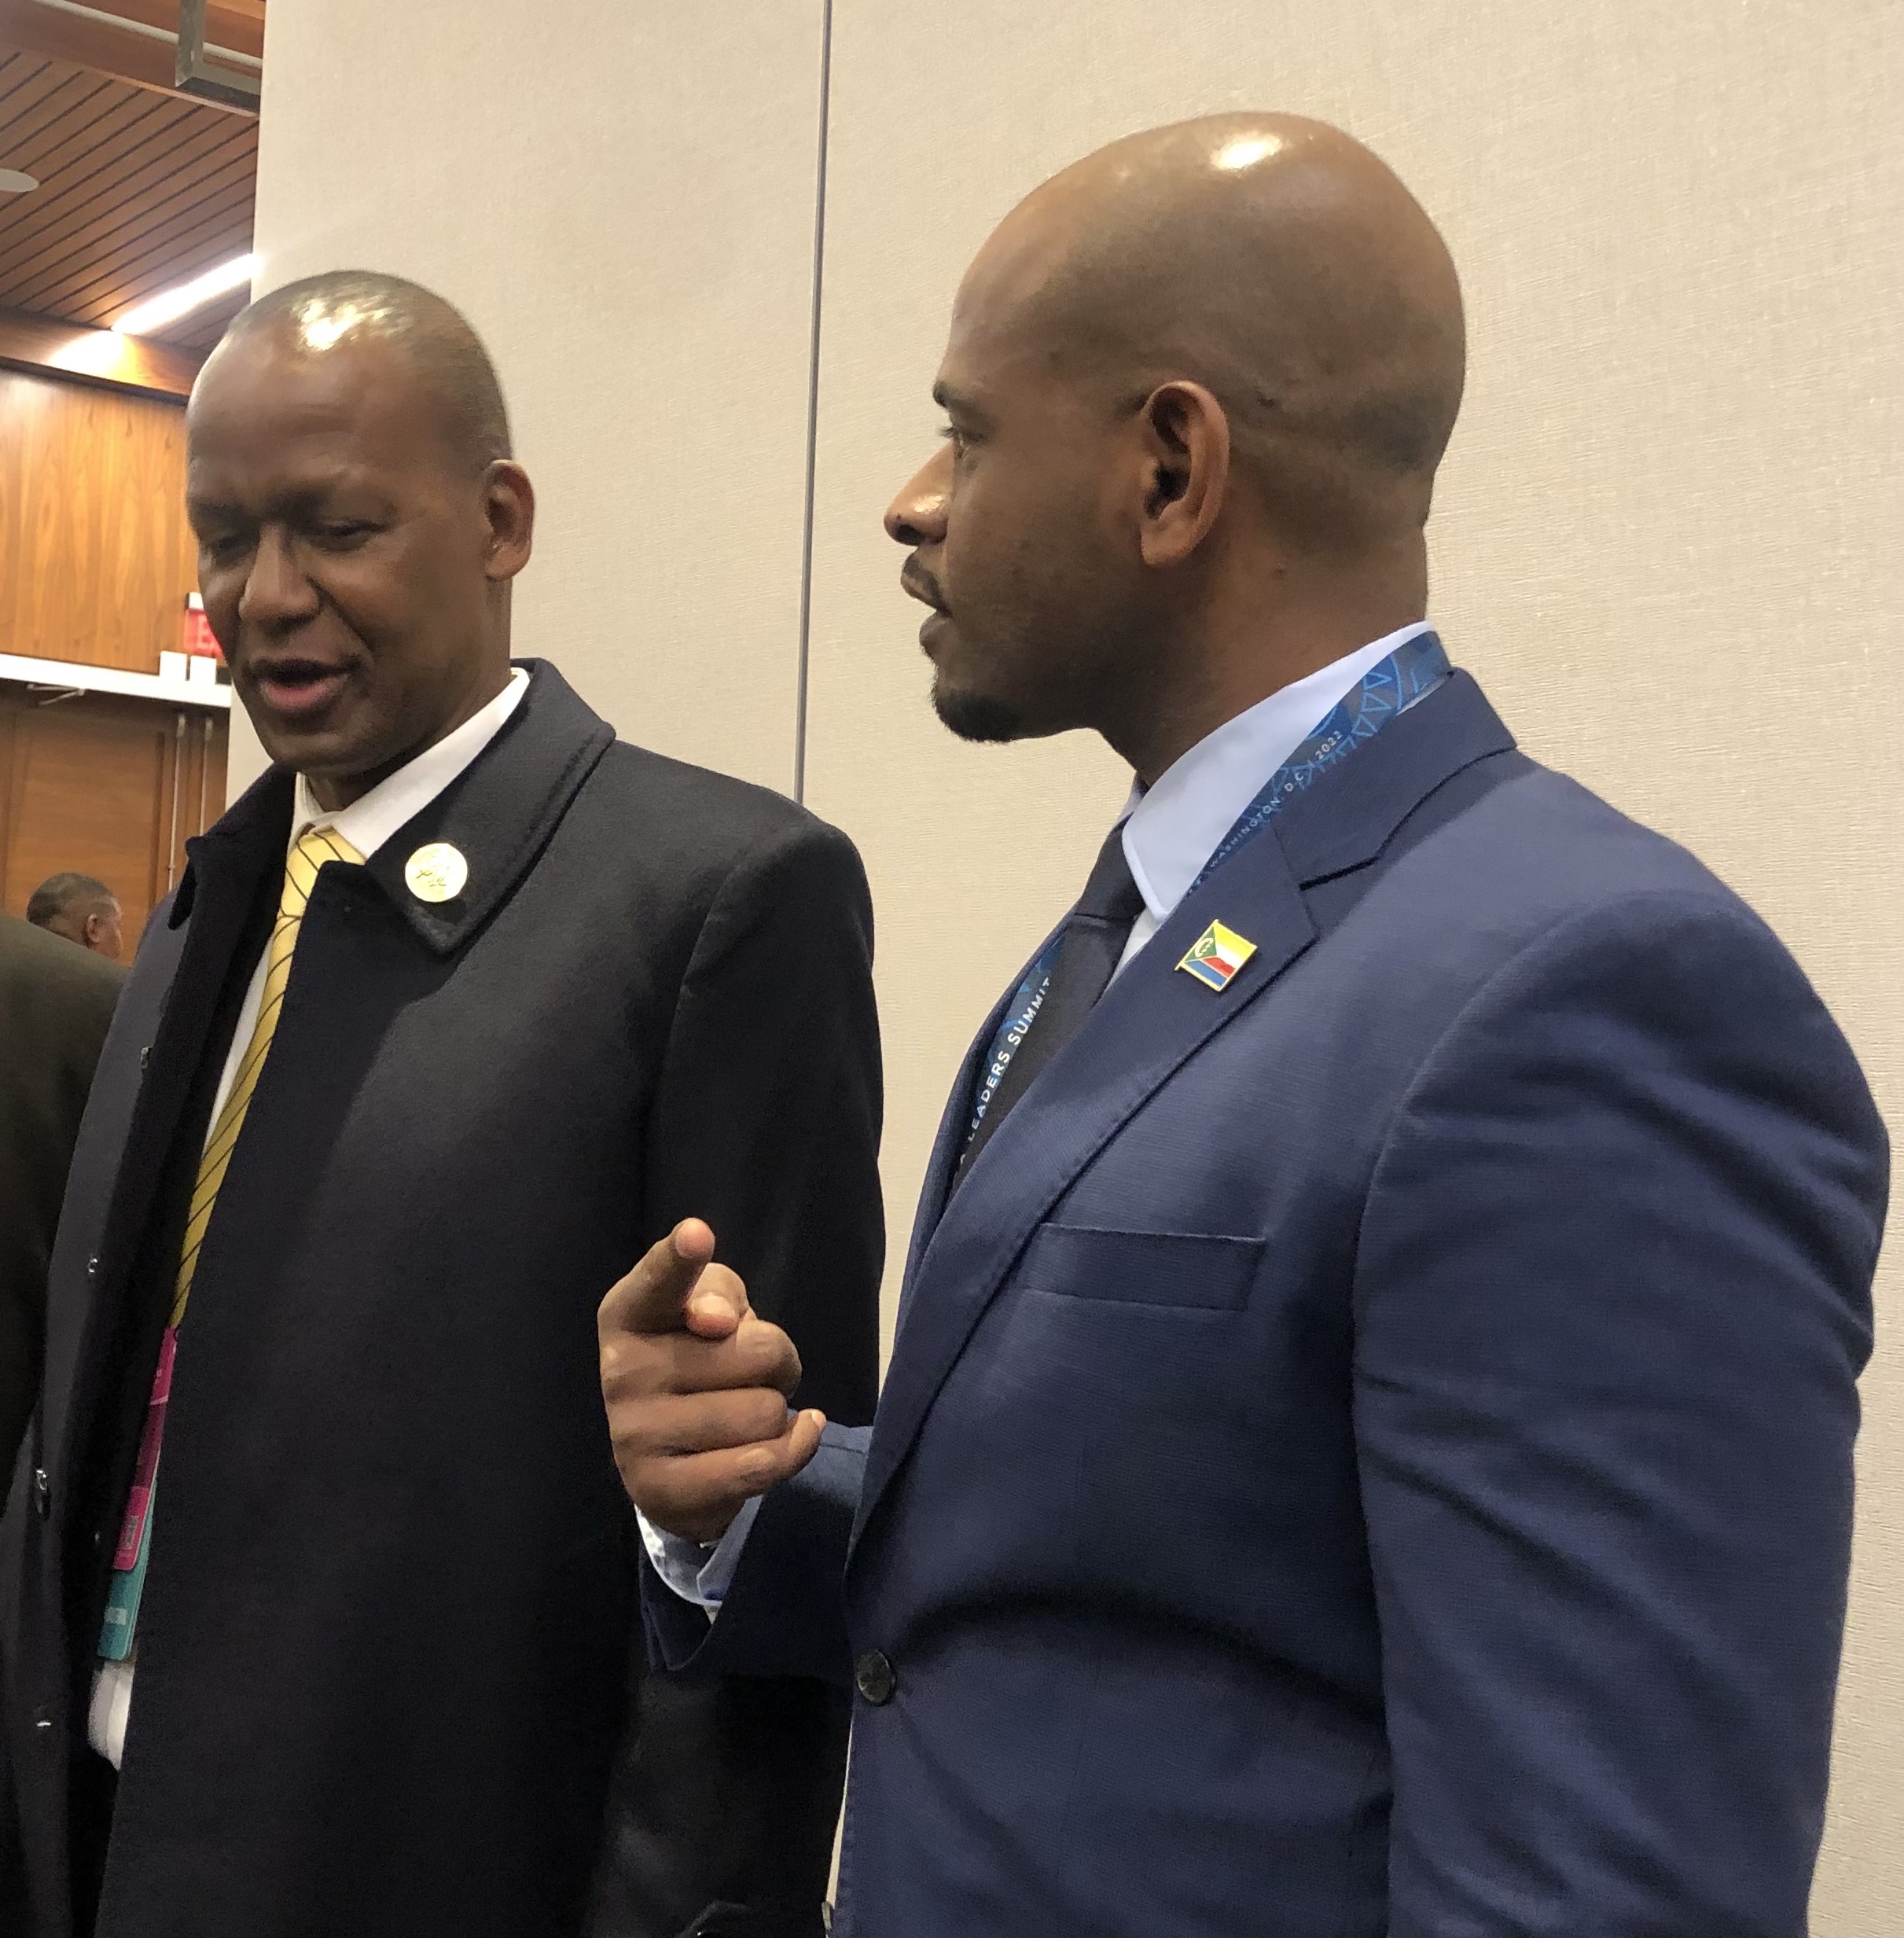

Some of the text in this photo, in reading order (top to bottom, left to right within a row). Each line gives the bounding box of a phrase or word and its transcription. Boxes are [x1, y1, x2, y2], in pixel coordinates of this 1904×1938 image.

[1314, 730, 1343, 759] 2022
[967, 976, 1050, 1142] LEADERS SUMMIT
